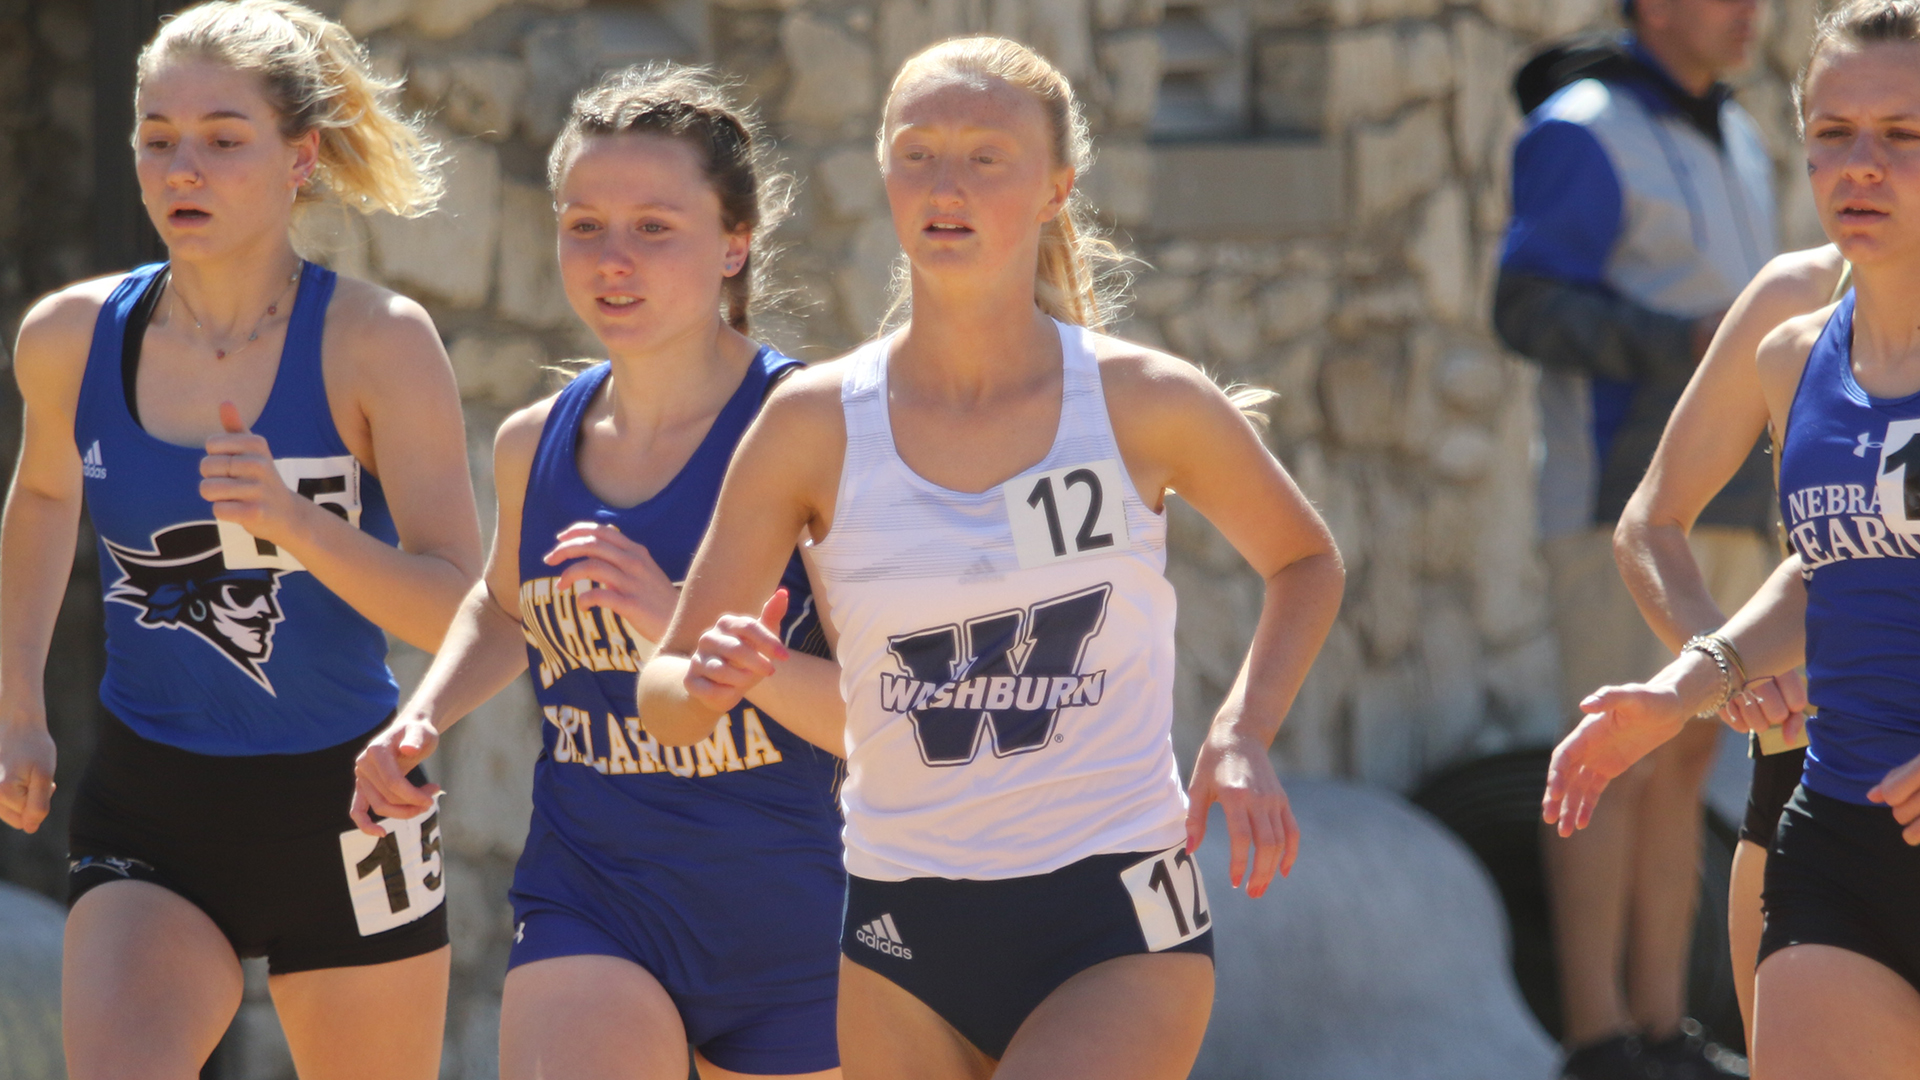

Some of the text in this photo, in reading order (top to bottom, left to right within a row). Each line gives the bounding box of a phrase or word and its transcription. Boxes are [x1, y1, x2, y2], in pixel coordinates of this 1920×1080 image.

[1026, 468, 1115, 557] 12
[880, 669, 1107, 713] WASHBURN
[356, 811, 441, 914] 15
[1148, 847, 1210, 938] 12
[855, 928, 913, 960] adidas
